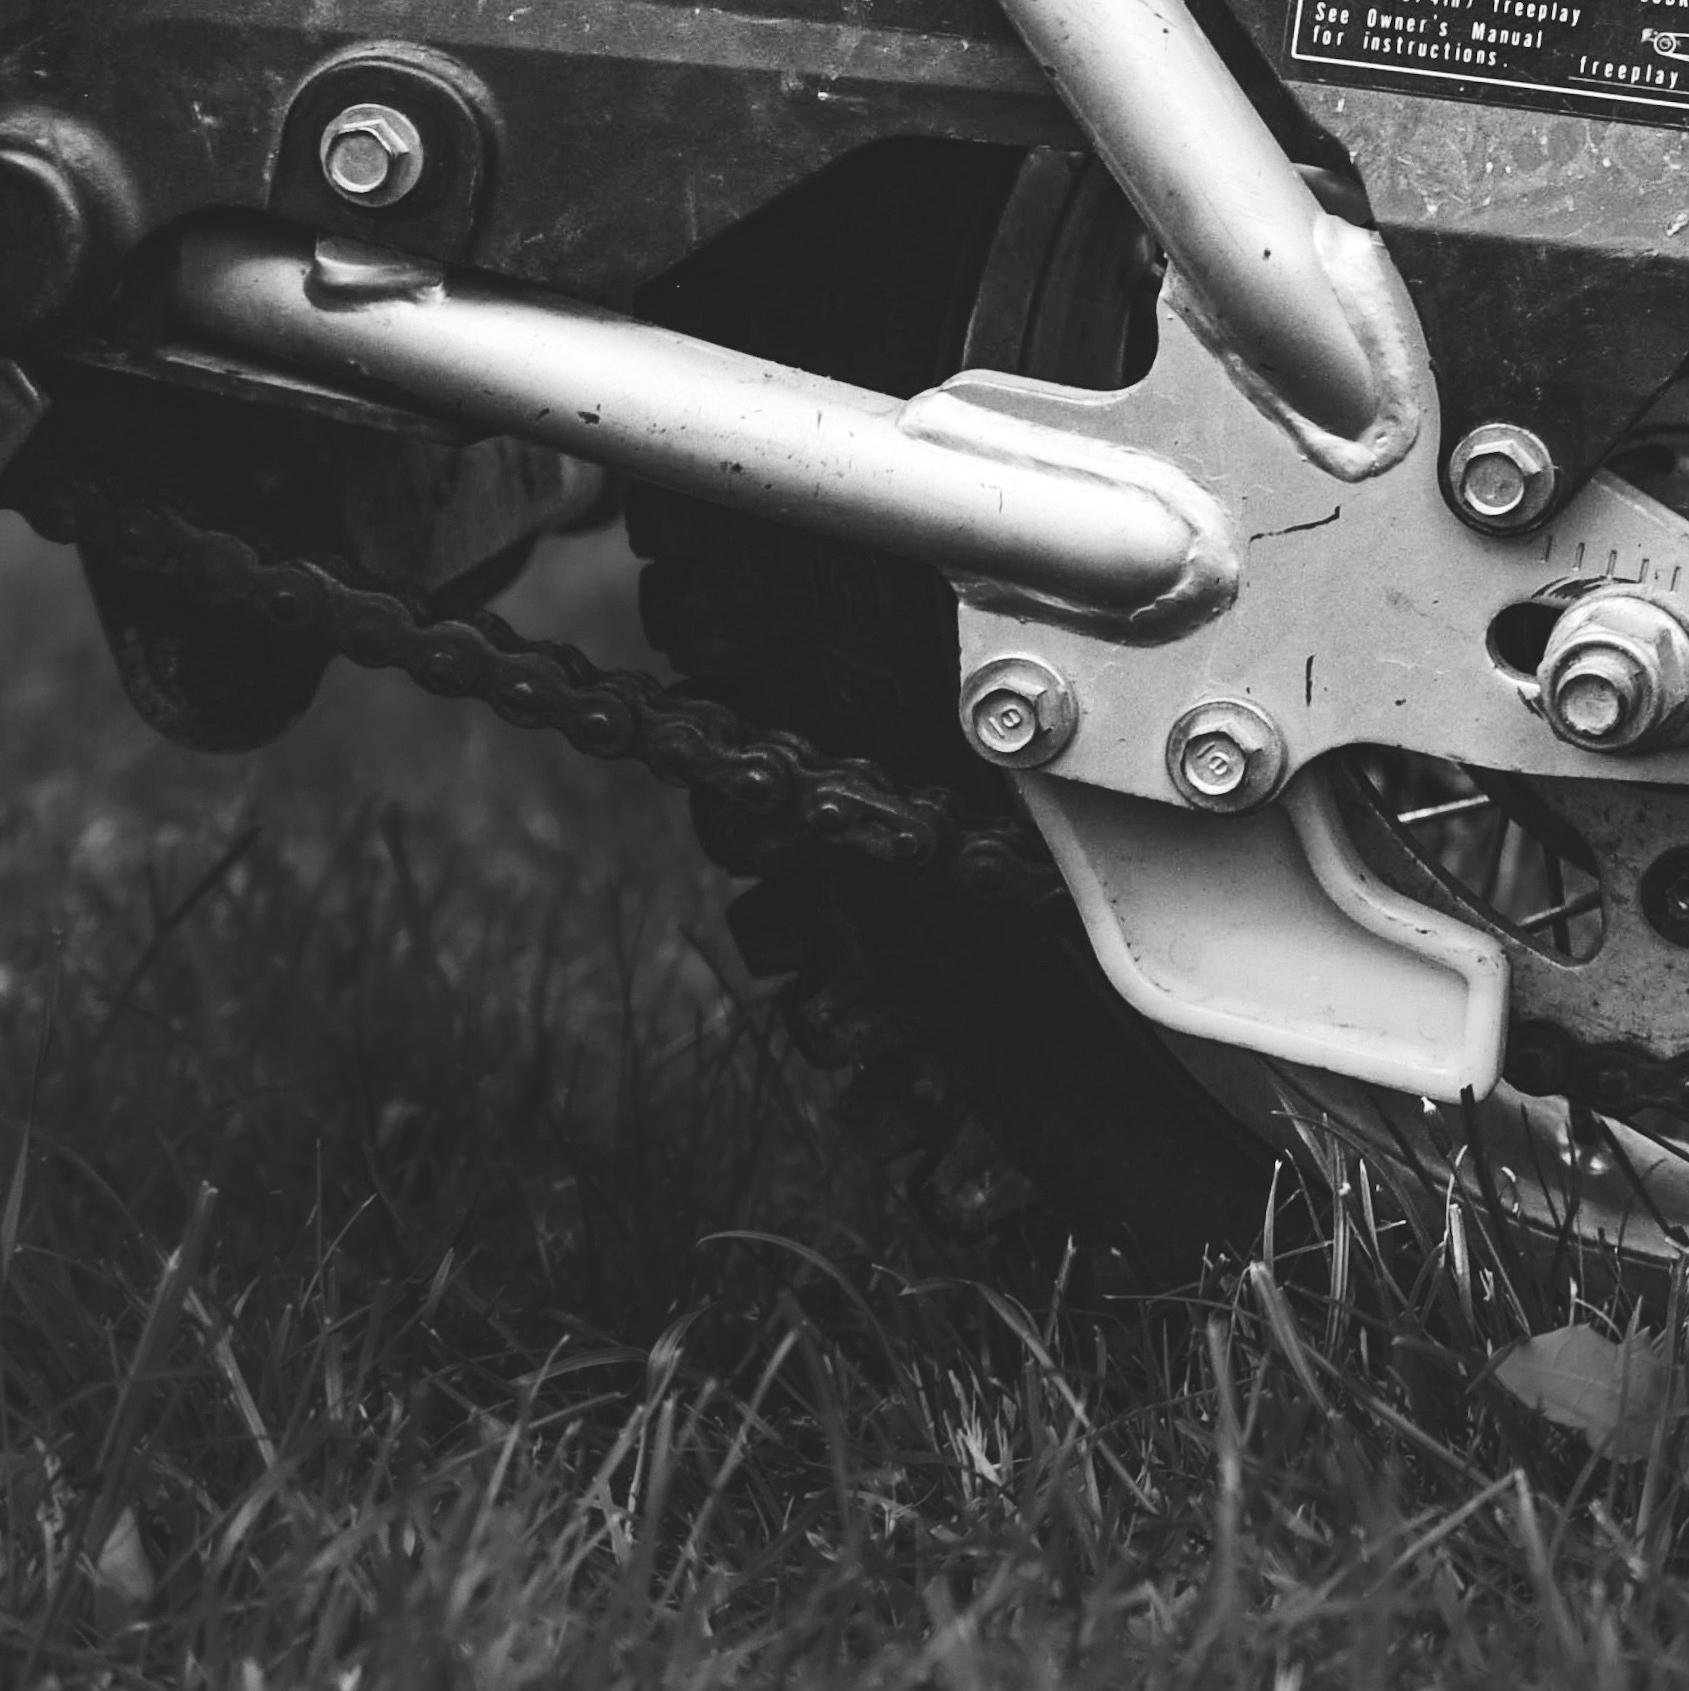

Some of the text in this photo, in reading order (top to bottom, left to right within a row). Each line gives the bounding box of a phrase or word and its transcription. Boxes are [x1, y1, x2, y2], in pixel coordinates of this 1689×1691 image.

[1311, 23, 1509, 69] for instructions.
[1314, 0, 1544, 50] See Owner's Manual
[1578, 54, 1680, 91] freeplay
